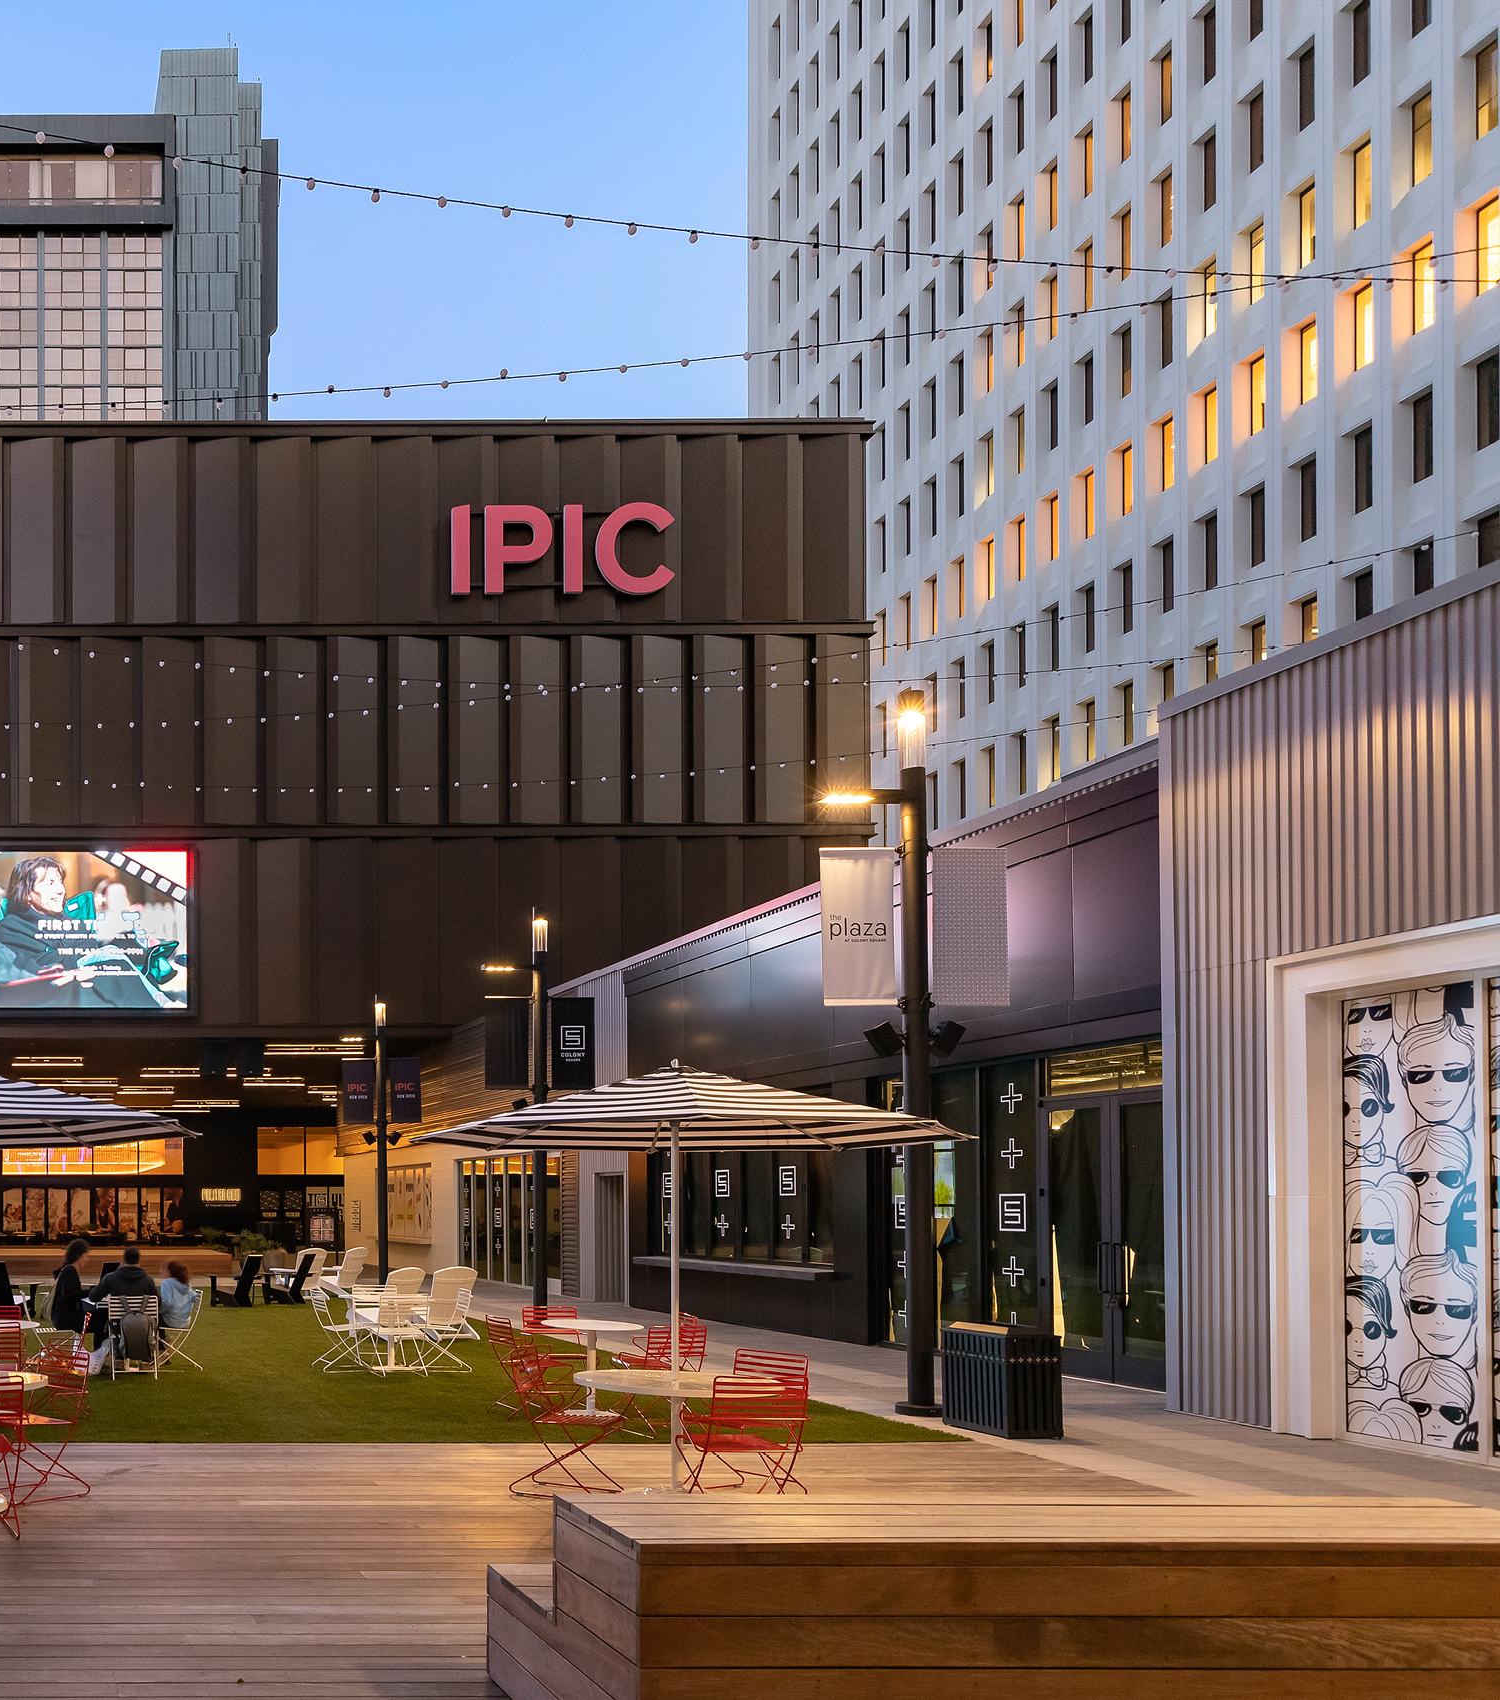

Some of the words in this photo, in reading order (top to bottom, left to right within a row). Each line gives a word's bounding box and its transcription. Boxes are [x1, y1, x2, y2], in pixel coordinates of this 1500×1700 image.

[451, 502, 676, 596] IPIC
[37, 919, 81, 931] FIRST
[829, 918, 887, 941] plaza
[57, 948, 74, 956] THE
[347, 1083, 367, 1092] IPIC
[395, 1082, 414, 1091] IPIC
